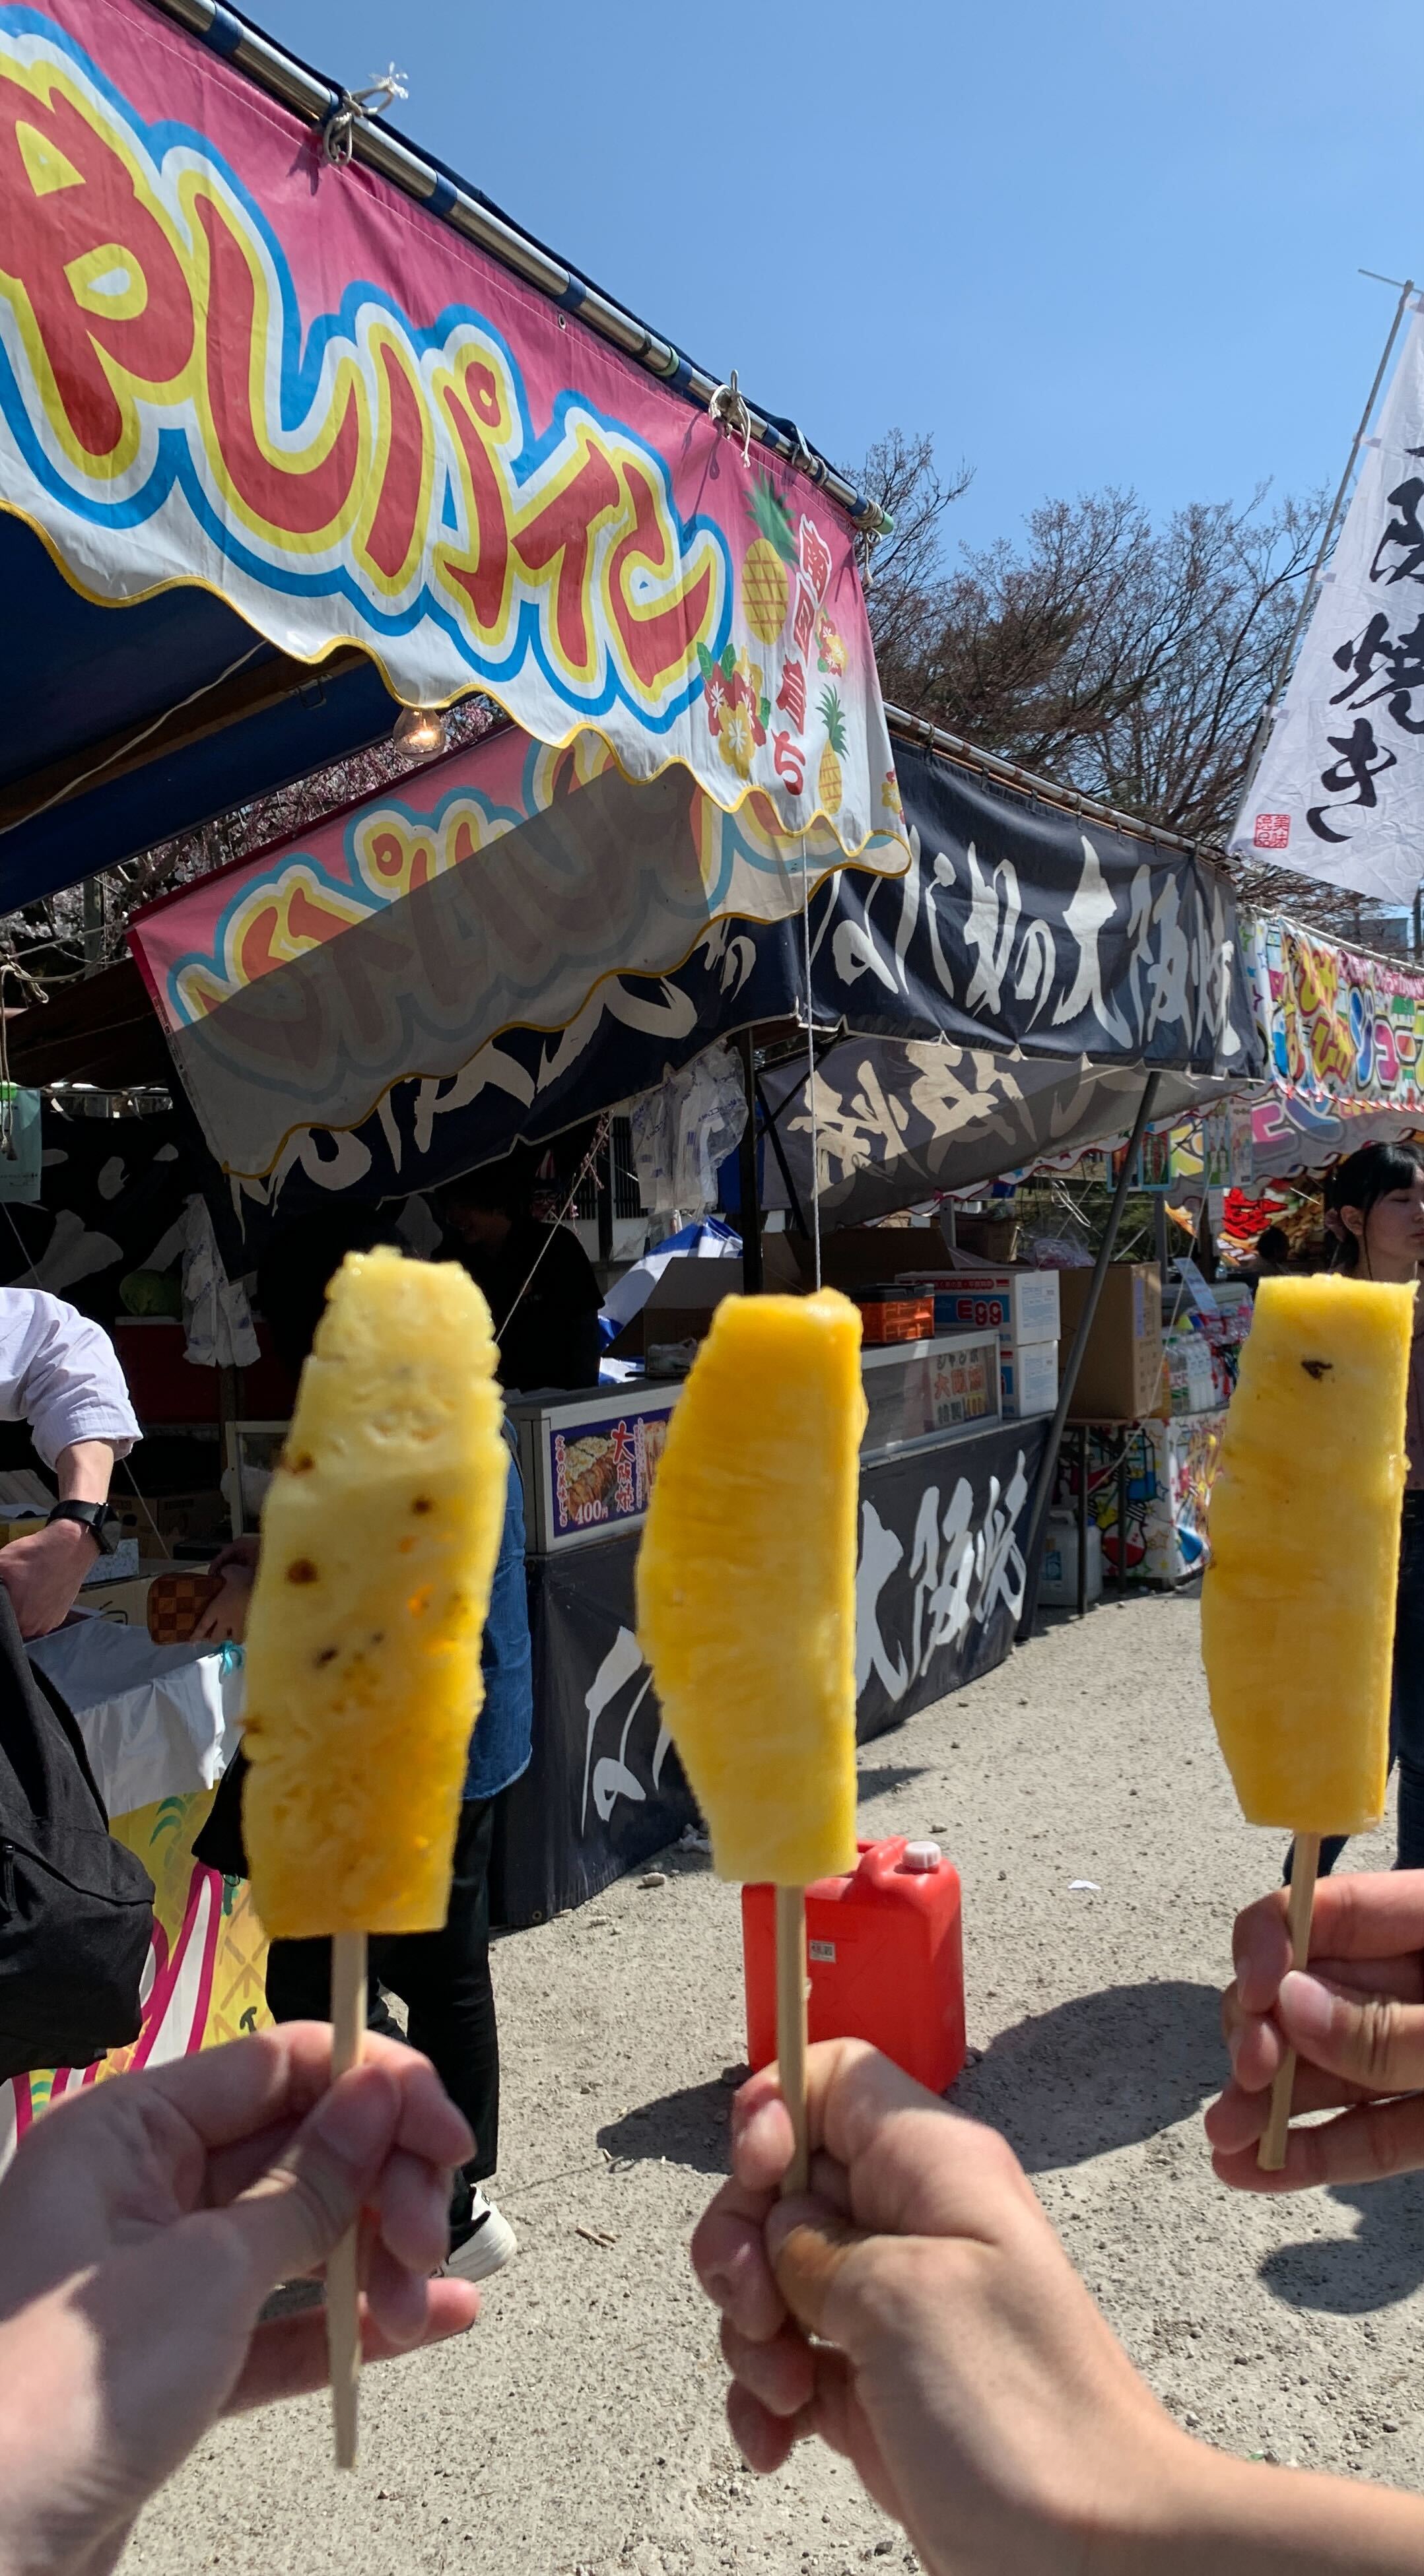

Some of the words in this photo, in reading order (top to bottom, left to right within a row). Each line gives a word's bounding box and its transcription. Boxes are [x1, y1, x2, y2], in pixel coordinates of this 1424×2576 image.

[957, 1299, 1002, 1327] Egg
[611, 1420, 634, 1512] 大阪焼
[576, 1500, 608, 1525] 400円
